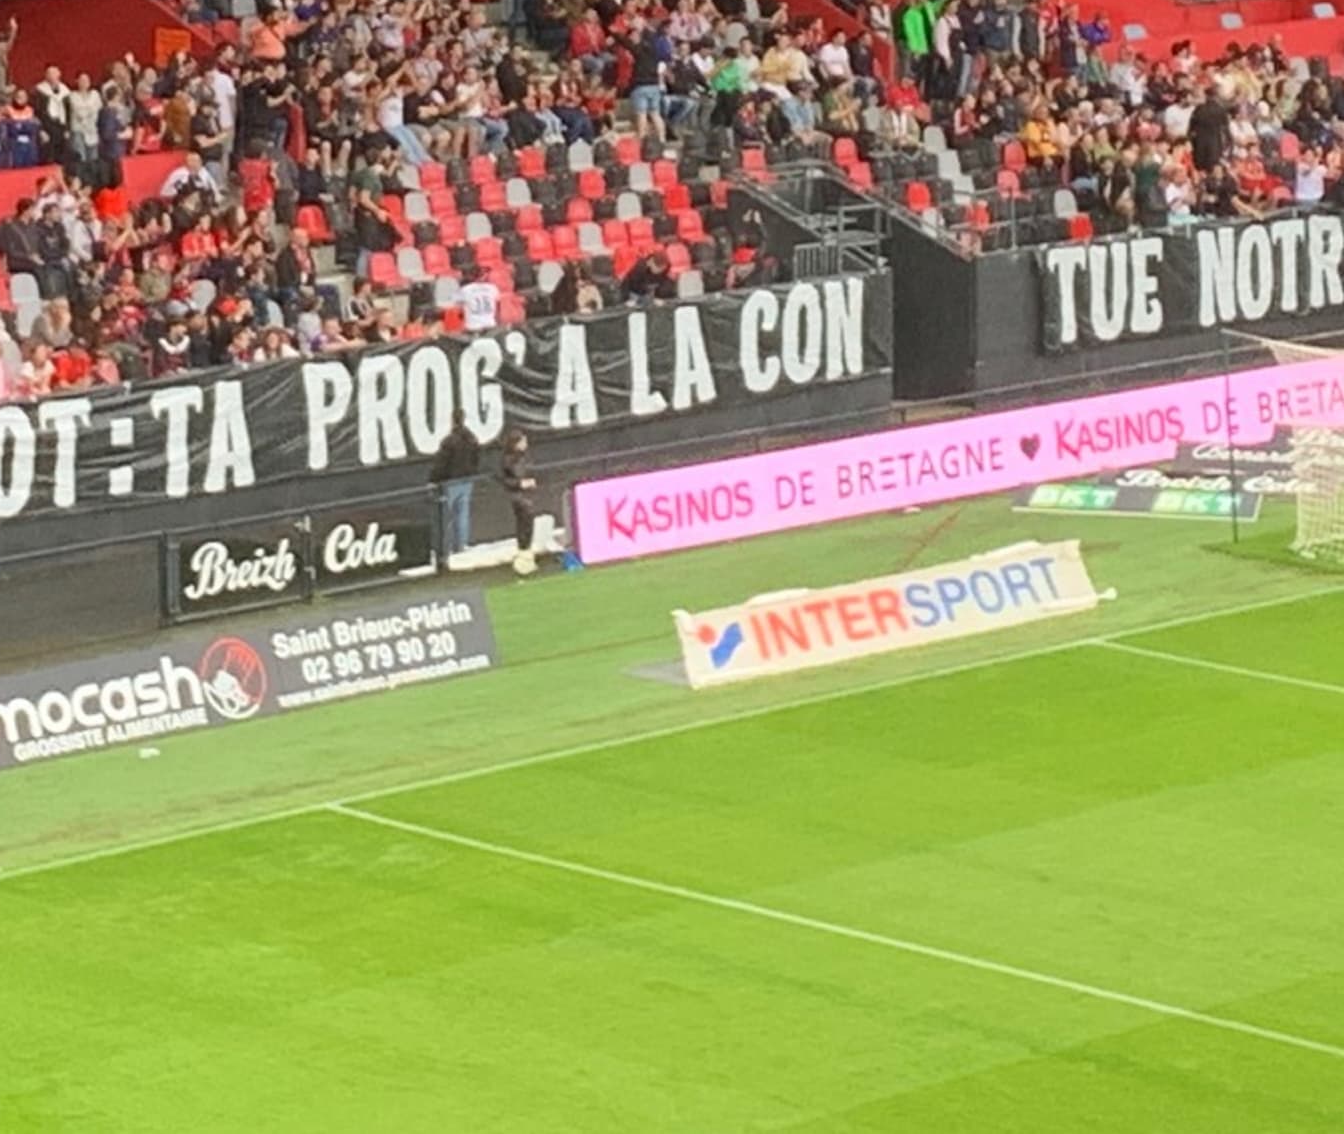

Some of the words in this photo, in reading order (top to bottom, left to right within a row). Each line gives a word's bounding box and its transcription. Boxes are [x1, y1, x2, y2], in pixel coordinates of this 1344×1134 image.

[1047, 237, 1163, 344] TUE
[628, 305, 716, 417] LA
[741, 278, 865, 396] CON
[1055, 403, 1185, 461] KASINOS
[1204, 396, 1239, 437] DE
[605, 481, 754, 541] KASINOS
[776, 470, 815, 510] DE
[838, 437, 1005, 500] BRETAGNE
[183, 538, 297, 601] Breizh
[324, 522, 398, 574] Cola
[272, 626, 332, 659] Saint
[332, 599, 473, 648] Brieuc-Plérin
[749, 558, 1061, 660] INTERSPORT
[301, 656, 333, 684] 02
[363, 642, 395, 671] 79
[396, 636, 426, 665] 90
[427, 630, 457, 658] 20
[13, 728, 106, 762] GROSSISTE
